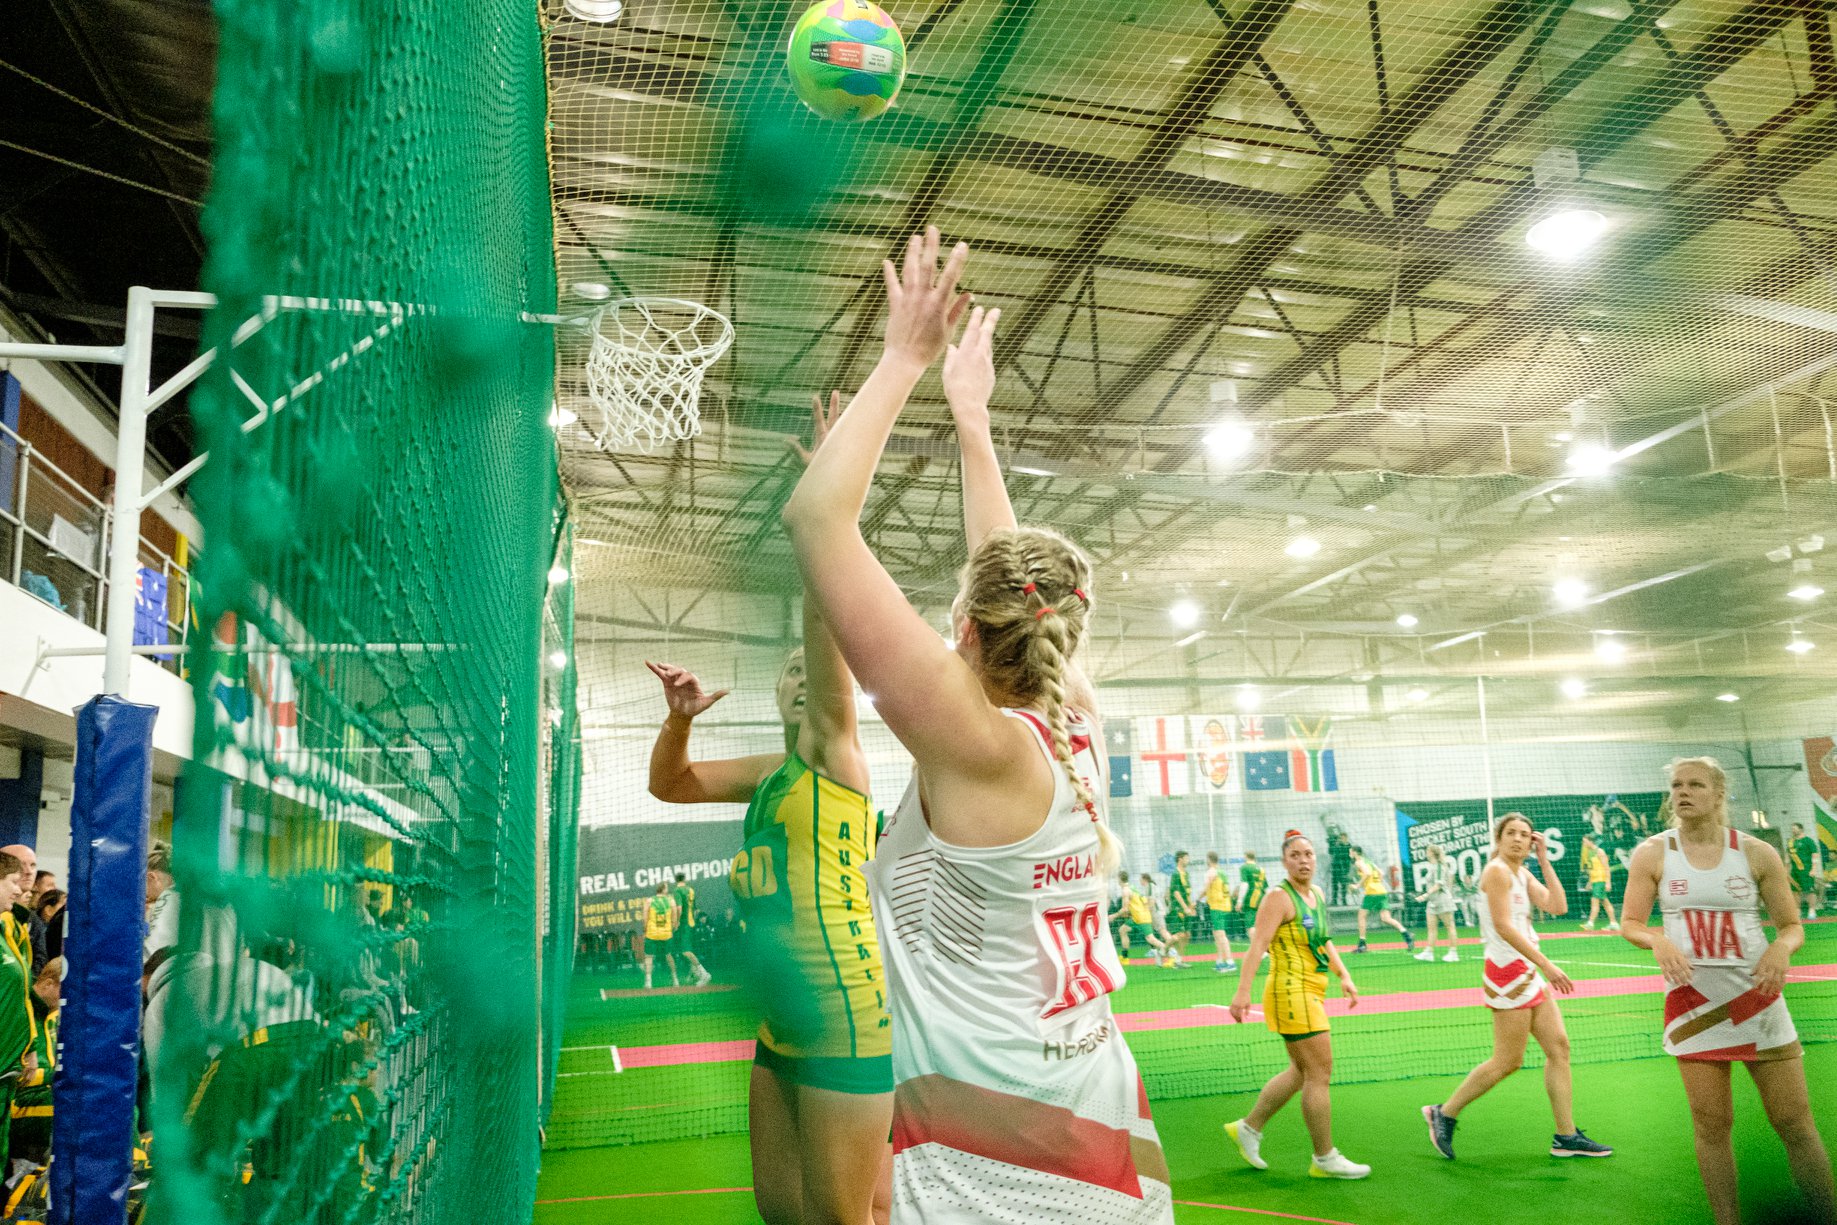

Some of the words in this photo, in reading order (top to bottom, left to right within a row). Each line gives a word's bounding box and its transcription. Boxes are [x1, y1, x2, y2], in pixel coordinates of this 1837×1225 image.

[1408, 819, 1451, 838] CHOSEN
[1450, 815, 1464, 828] BY
[1410, 829, 1452, 850] CRICKET
[1453, 821, 1488, 839] SOUTH
[580, 871, 630, 894] REAL
[1033, 854, 1098, 889] ENGLA
[583, 915, 604, 927] YOU
[607, 912, 632, 924] WILL
[1682, 908, 1745, 959] WA
